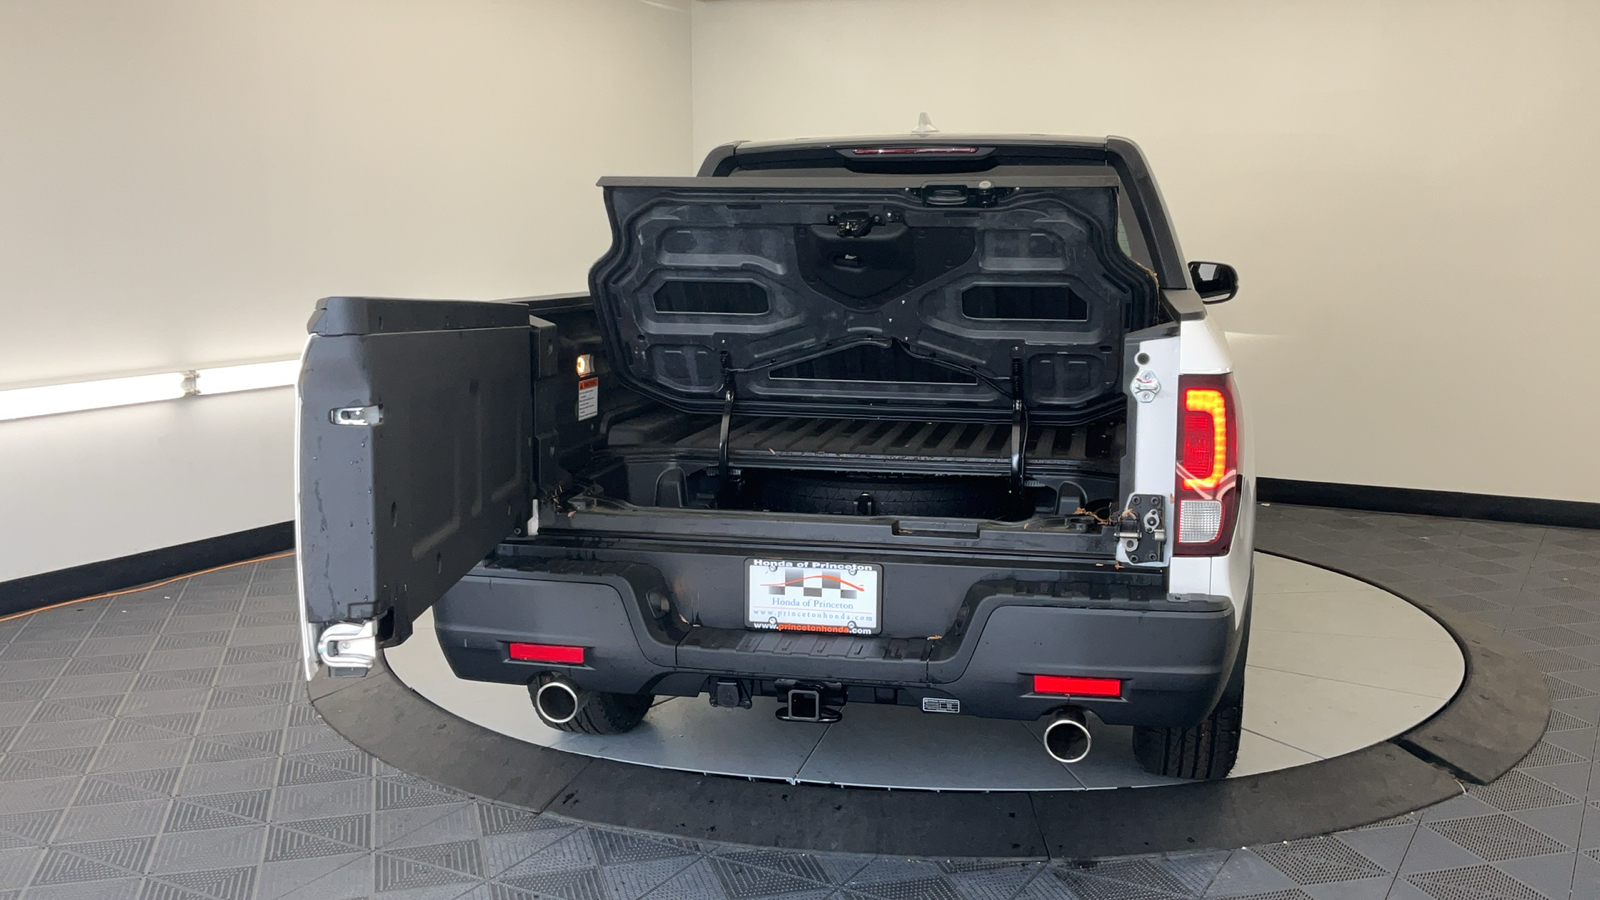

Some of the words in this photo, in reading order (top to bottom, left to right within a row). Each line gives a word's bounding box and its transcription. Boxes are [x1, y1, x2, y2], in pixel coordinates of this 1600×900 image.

[753, 559, 794, 568] Honda
[796, 560, 809, 568] of
[812, 561, 873, 571] Princeton
[772, 597, 801, 607] Honda
[802, 598, 811, 607] of
[813, 599, 854, 610] Princeton
[753, 610, 873, 622] www.princetonhonda.com
[753, 622, 872, 635] www.princetonhonda.com
